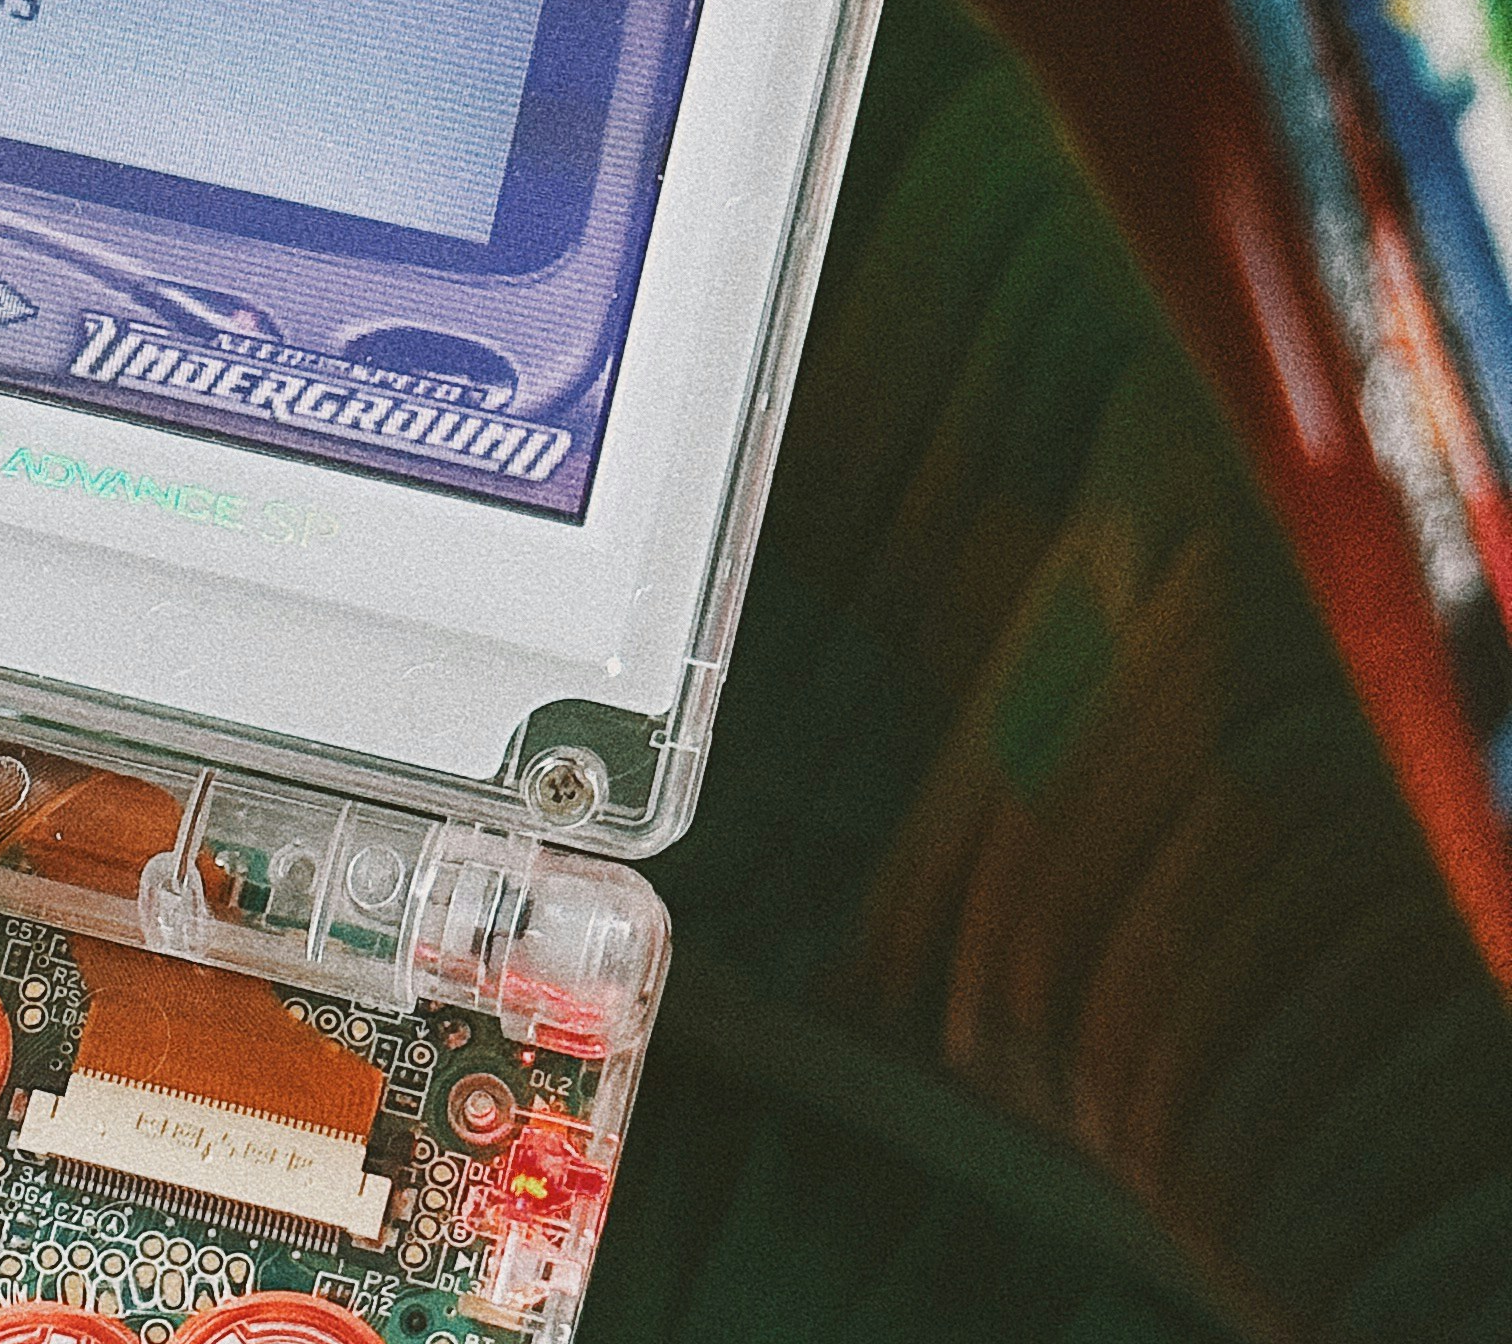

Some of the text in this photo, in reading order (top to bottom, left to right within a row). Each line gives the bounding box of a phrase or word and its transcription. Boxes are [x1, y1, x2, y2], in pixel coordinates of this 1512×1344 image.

[69, 311, 572, 483] UNDERGROUND
[2, 445, 250, 532] ADVANCE
[259, 499, 341, 548] SP
[5, 918, 48, 941] C57
[531, 1068, 574, 1097] DL2
[19, 1164, 49, 1188] 34
[55, 1204, 97, 1227] C76
